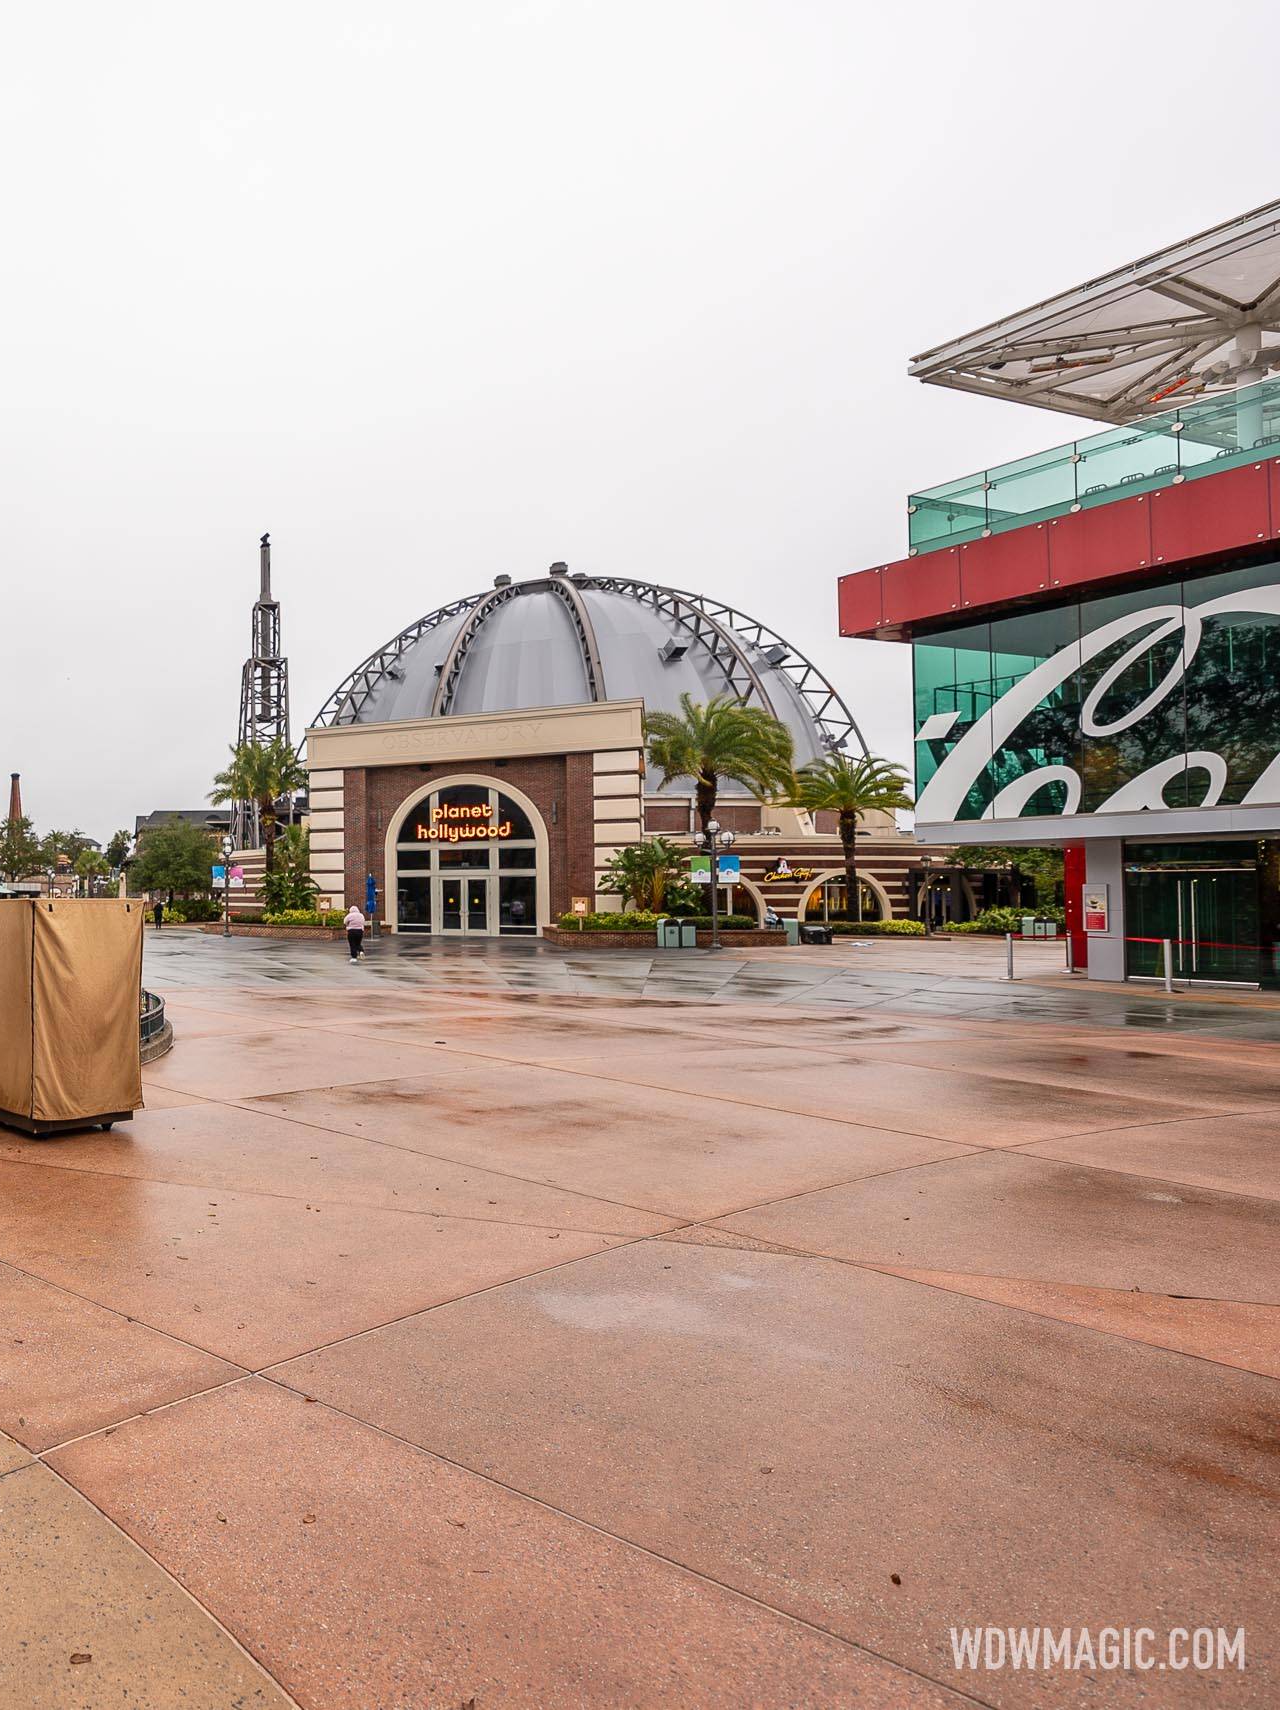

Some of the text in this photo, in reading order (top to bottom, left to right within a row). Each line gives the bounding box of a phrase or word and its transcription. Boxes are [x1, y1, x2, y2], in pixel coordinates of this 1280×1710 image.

[382, 722, 543, 750] OBSERVATORY
[432, 804, 493, 822] planet
[417, 822, 511, 842] hollywood
